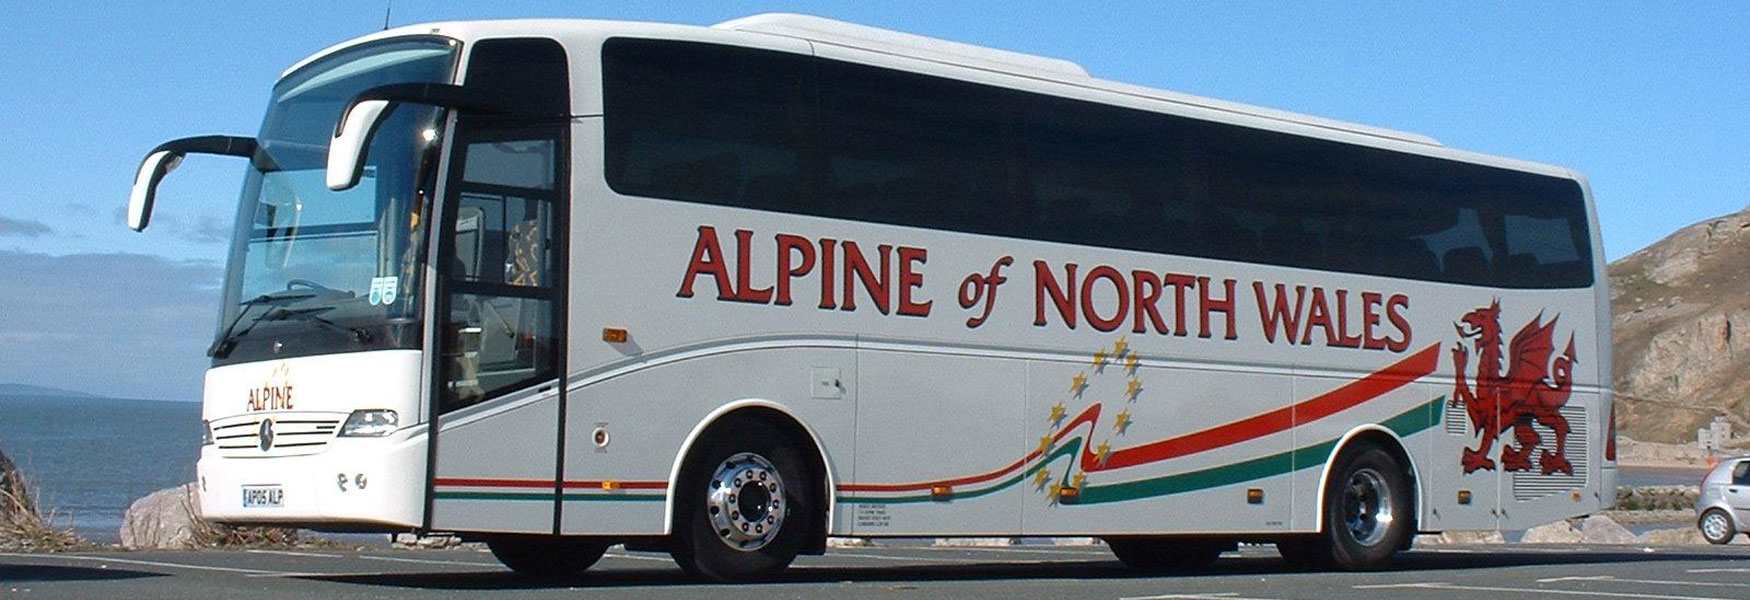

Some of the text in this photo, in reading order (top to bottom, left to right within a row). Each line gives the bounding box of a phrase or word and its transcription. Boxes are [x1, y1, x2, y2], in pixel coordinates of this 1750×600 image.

[676, 225, 1413, 353] ALPINE of NORTH WALES
[246, 386, 294, 411] ALPINE
